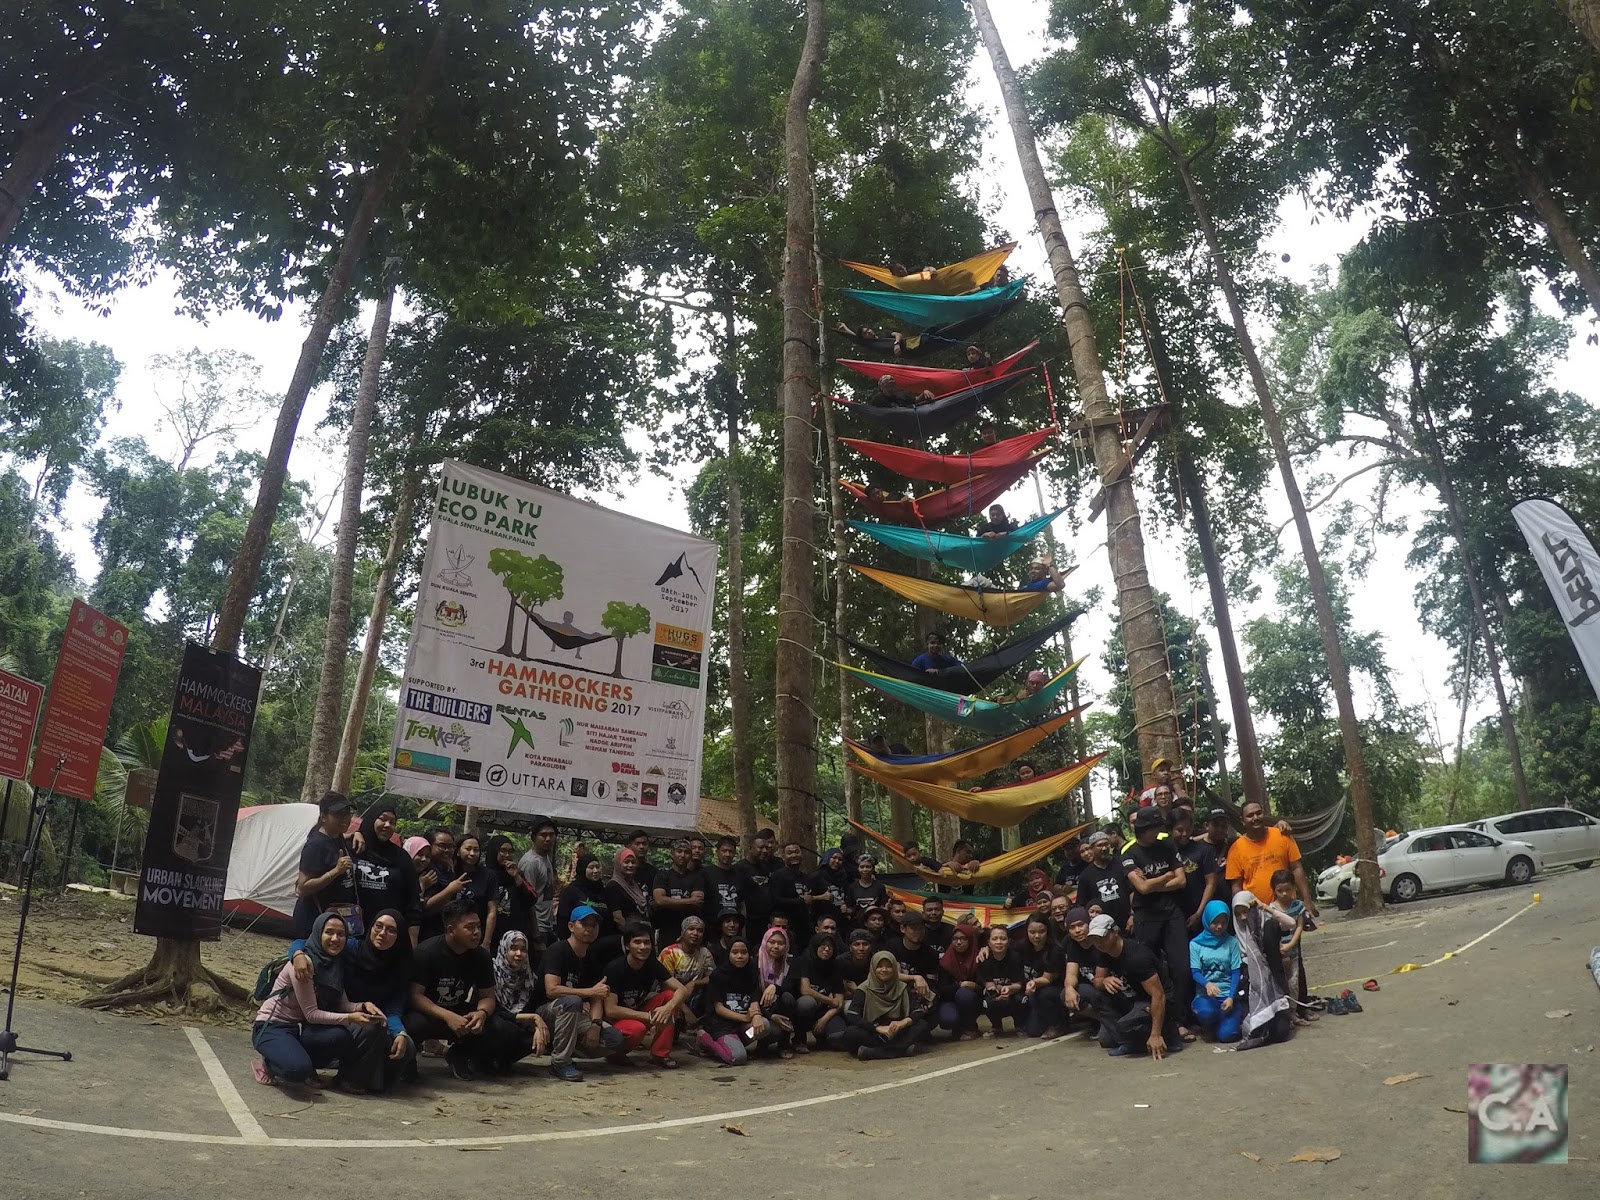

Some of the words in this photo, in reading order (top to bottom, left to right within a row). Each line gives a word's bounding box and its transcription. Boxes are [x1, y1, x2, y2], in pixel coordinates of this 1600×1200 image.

[442, 476, 509, 510] LUBUK
[516, 498, 543, 519] YU
[437, 514, 459, 526] KUALA
[438, 497, 477, 521] ECO
[484, 511, 540, 540] PARK
[430, 582, 442, 590] DUN
[442, 585, 459, 594] KUALA
[459, 590, 478, 599] SENTUL
[660, 594, 698, 608] September
[670, 604, 689, 614] 2017
[668, 628, 698, 642] HUGS
[408, 677, 445, 692] SUPPORTED
[447, 686, 458, 695] BY:
[469, 658, 485, 670] 3rd
[487, 659, 633, 701] HAMMOCKERS
[179, 676, 253, 714] HAMMOCKERS
[410, 690, 431, 711] THE
[498, 679, 608, 713] GATHERING
[611, 702, 641, 717] 2017
[179, 695, 247, 730] MALAYSIA
[404, 719, 472, 749] Trekkerz
[576, 721, 589, 729] NUR
[610, 741, 633, 750] ARIFFIN
[618, 735, 637, 743] TAHER
[524, 752, 540, 761] KOTA
[541, 755, 573, 766] KINABALU
[530, 760, 567, 772] PARAGLIDER
[620, 768, 640, 776] RAVEN
[512, 773, 566, 793] UTTARA
[146, 867, 182, 888] URBAN
[183, 873, 224, 893] SLACKLINE
[142, 884, 223, 911] MOVEMENT
